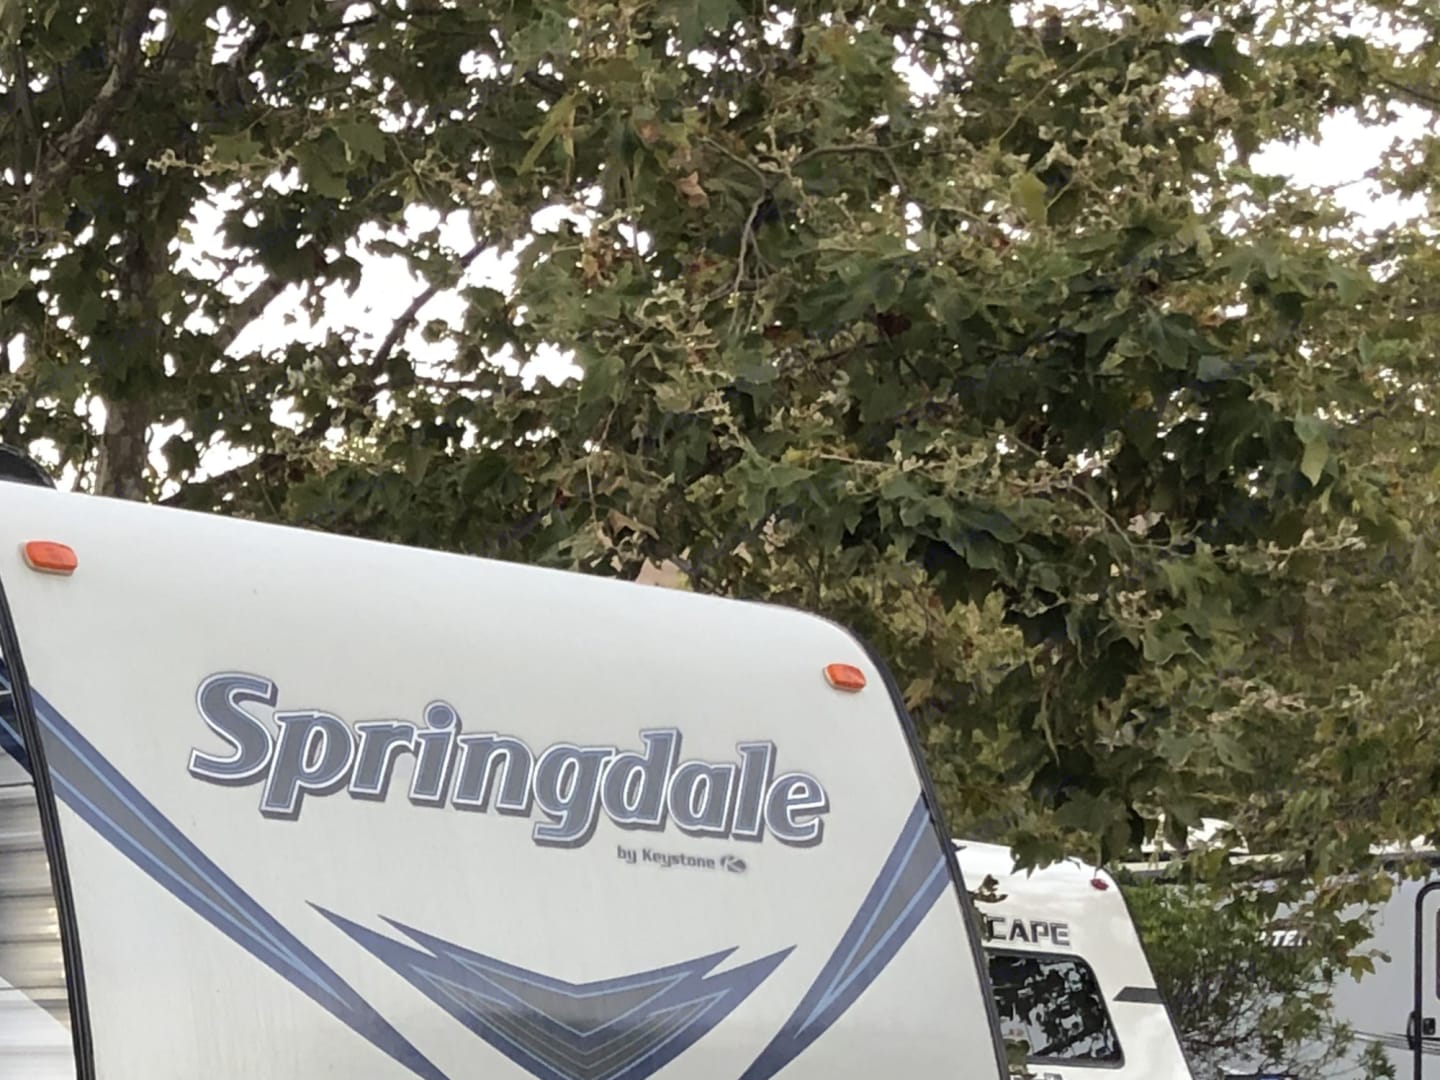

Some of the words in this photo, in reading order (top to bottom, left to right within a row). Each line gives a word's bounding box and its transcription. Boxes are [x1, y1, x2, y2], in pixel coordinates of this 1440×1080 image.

[187, 671, 828, 848] Springdale
[617, 845, 637, 864] by
[642, 847, 715, 868] Keystone
[985, 915, 1071, 946] CAPE
